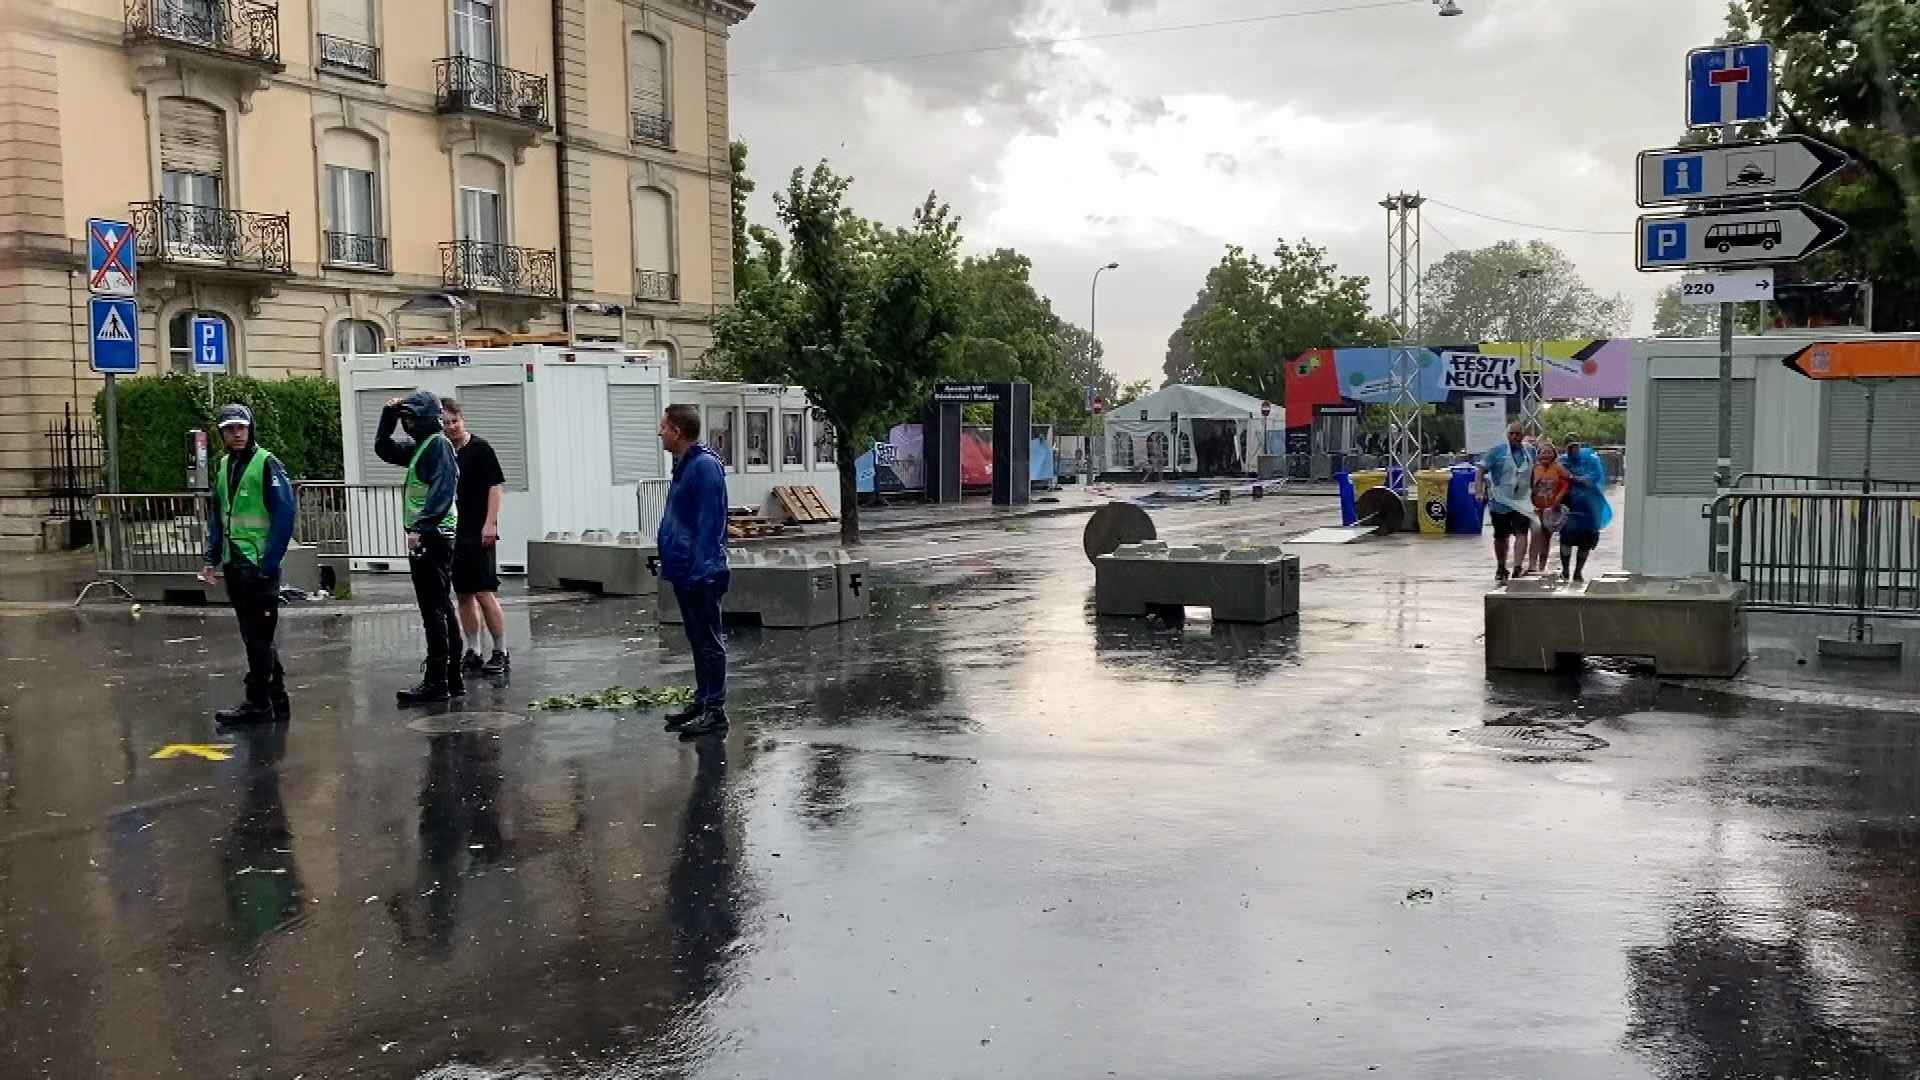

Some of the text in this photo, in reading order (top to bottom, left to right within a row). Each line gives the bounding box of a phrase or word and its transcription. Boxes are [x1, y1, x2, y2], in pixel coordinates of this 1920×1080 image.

[1675, 161, 1690, 189] i
[1657, 229, 1678, 257] P
[1683, 283, 1715, 295] 220
[203, 325, 216, 345] P
[1445, 370, 1513, 391] NEUCH
